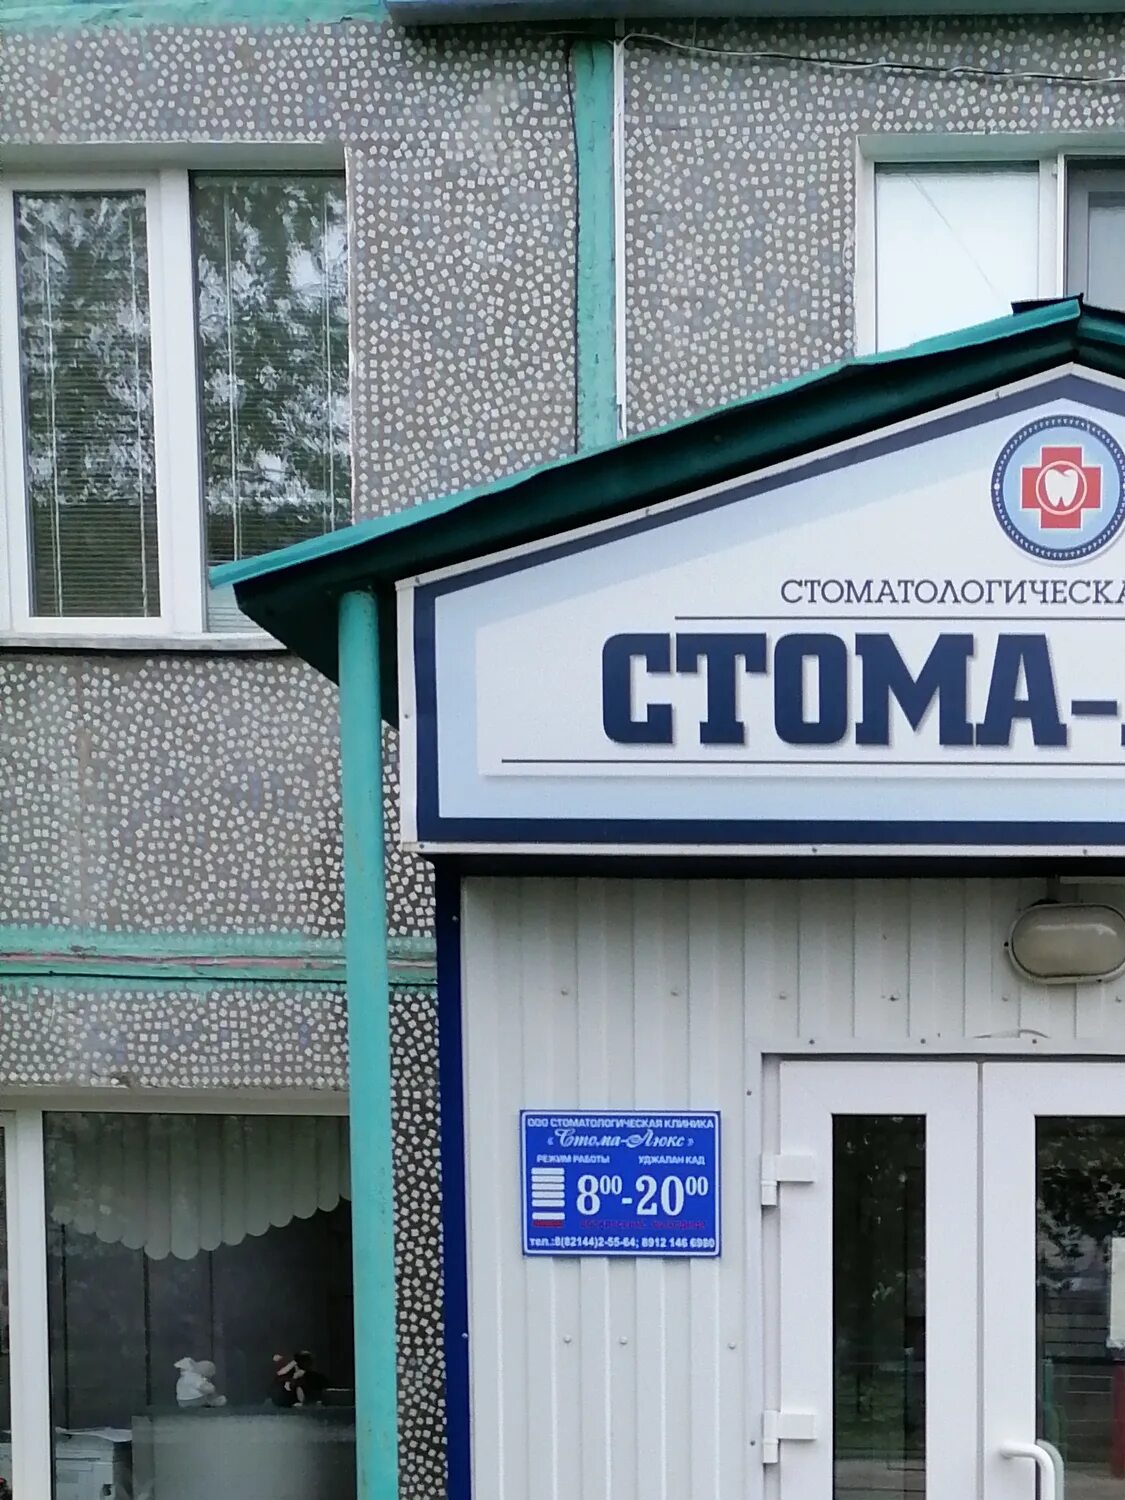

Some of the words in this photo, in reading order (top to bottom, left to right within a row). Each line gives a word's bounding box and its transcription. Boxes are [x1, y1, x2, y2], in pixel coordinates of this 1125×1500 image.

[527, 1118, 549, 1127] ООО
[550, 1118, 663, 1129] СТОМАТОЛОГИЧЕСКАЯ
[664, 1119, 715, 1129] КЛИНИКА
[536, 1154, 572, 1164] РЕЖИМ
[573, 1154, 610, 1164] РАБОТЫ
[685, 1155, 706, 1166] КАД
[641, 1237, 667, 1248] 8912
